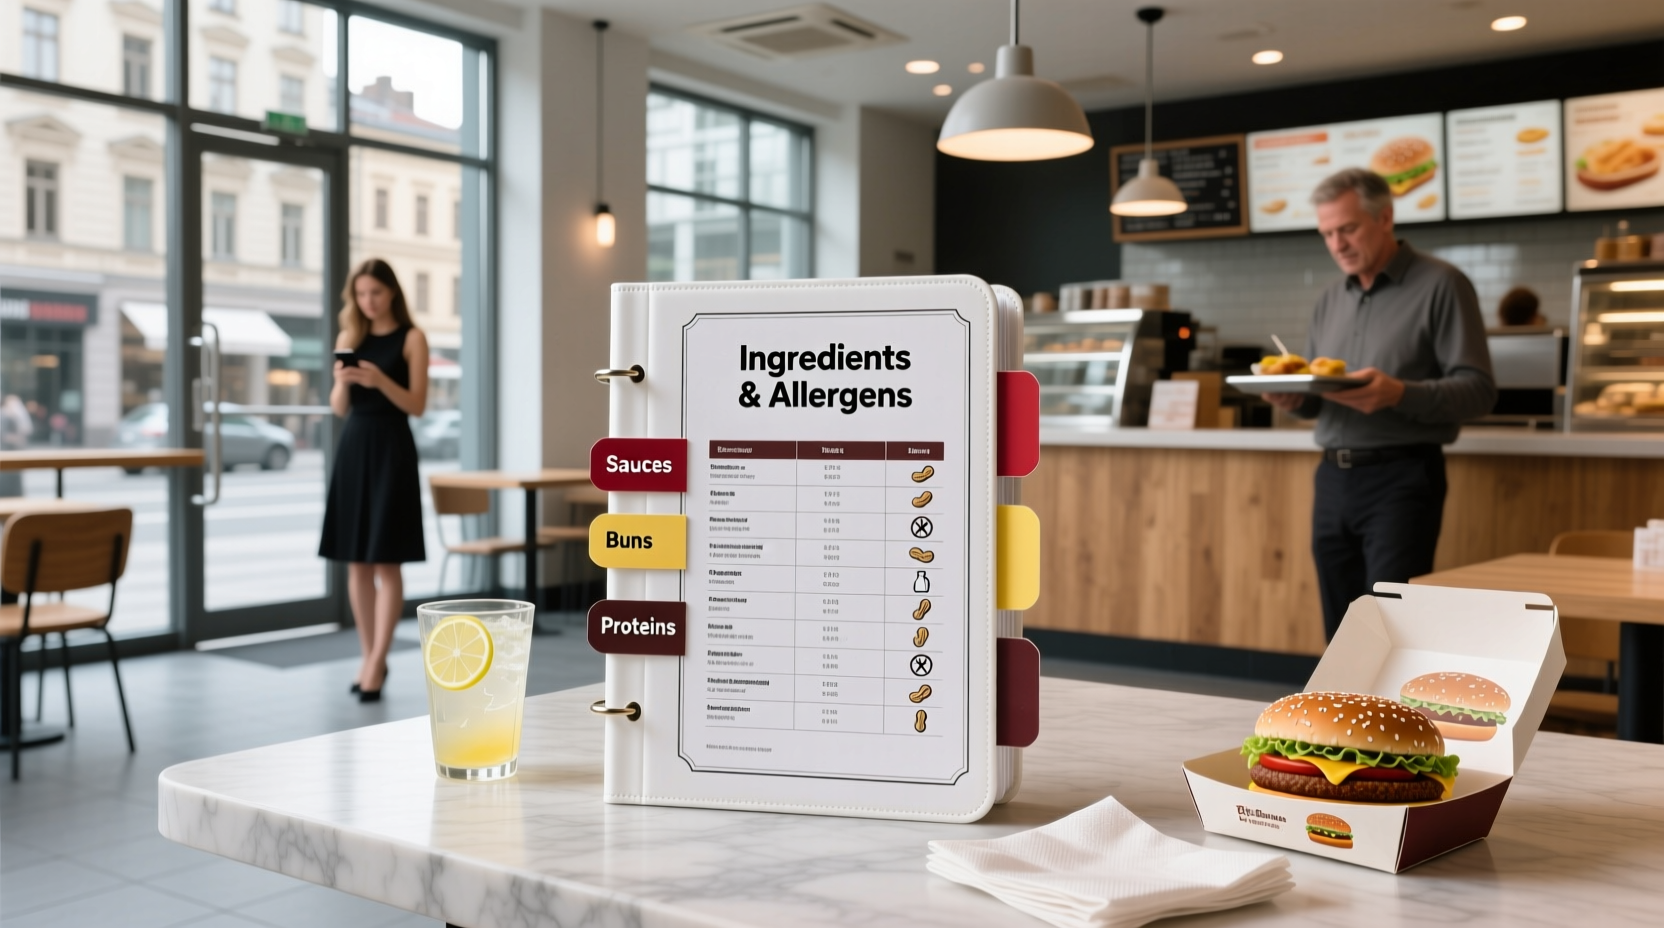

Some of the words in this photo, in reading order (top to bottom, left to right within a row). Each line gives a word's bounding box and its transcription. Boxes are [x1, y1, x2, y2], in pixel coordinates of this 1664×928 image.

[740, 343, 911, 377] Ingredients
[738, 381, 761, 408] &
[768, 381, 913, 415] Allergens
[606, 455, 672, 474] Sauces
[606, 531, 653, 549] Buns
[601, 616, 676, 636] Proteins
